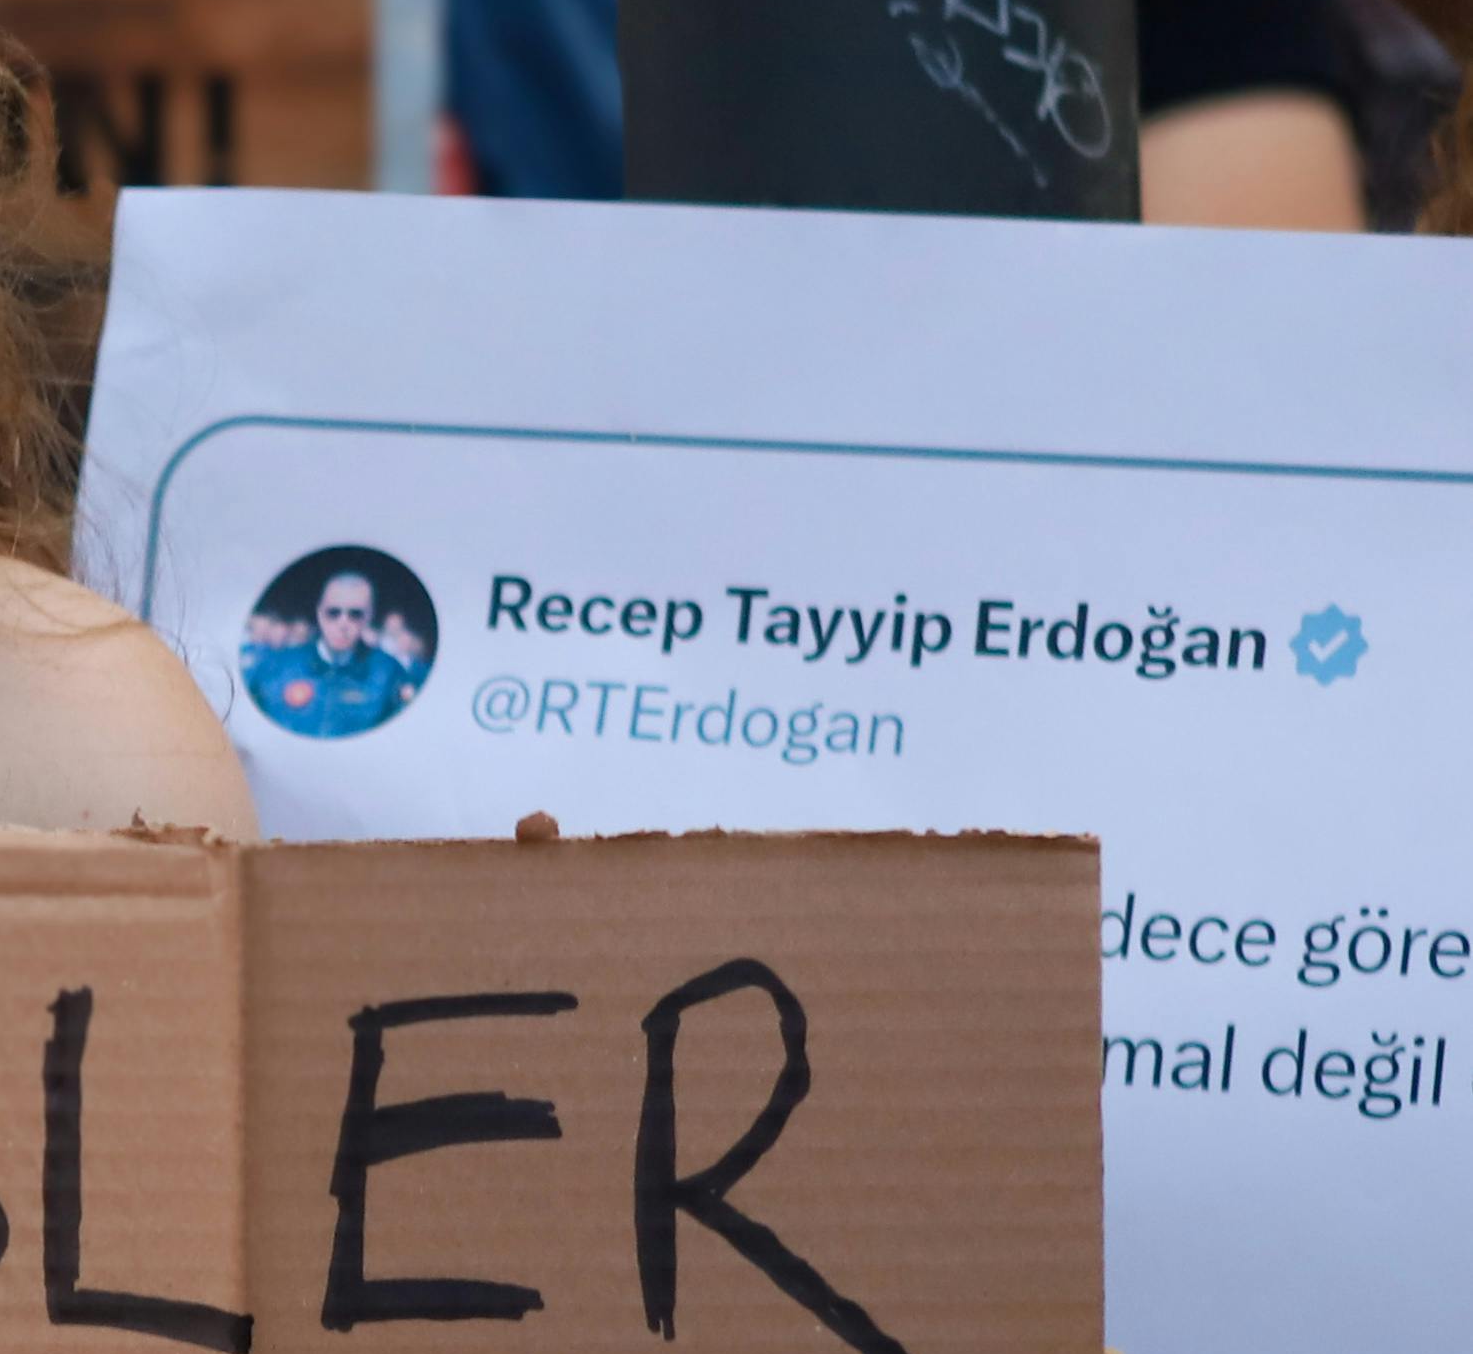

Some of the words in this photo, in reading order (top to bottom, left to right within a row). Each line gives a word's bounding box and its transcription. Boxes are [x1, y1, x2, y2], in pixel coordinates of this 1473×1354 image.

[487, 574, 704, 655] Recep
[725, 586, 954, 668] Tayyip
[973, 598, 1268, 681] Erdoğan
[471, 675, 907, 766] @RTErdogan
[1296, 905, 1472, 989] göre
[1102, 1023, 1236, 1093] mal
[1261, 1027, 1447, 1121] değil
